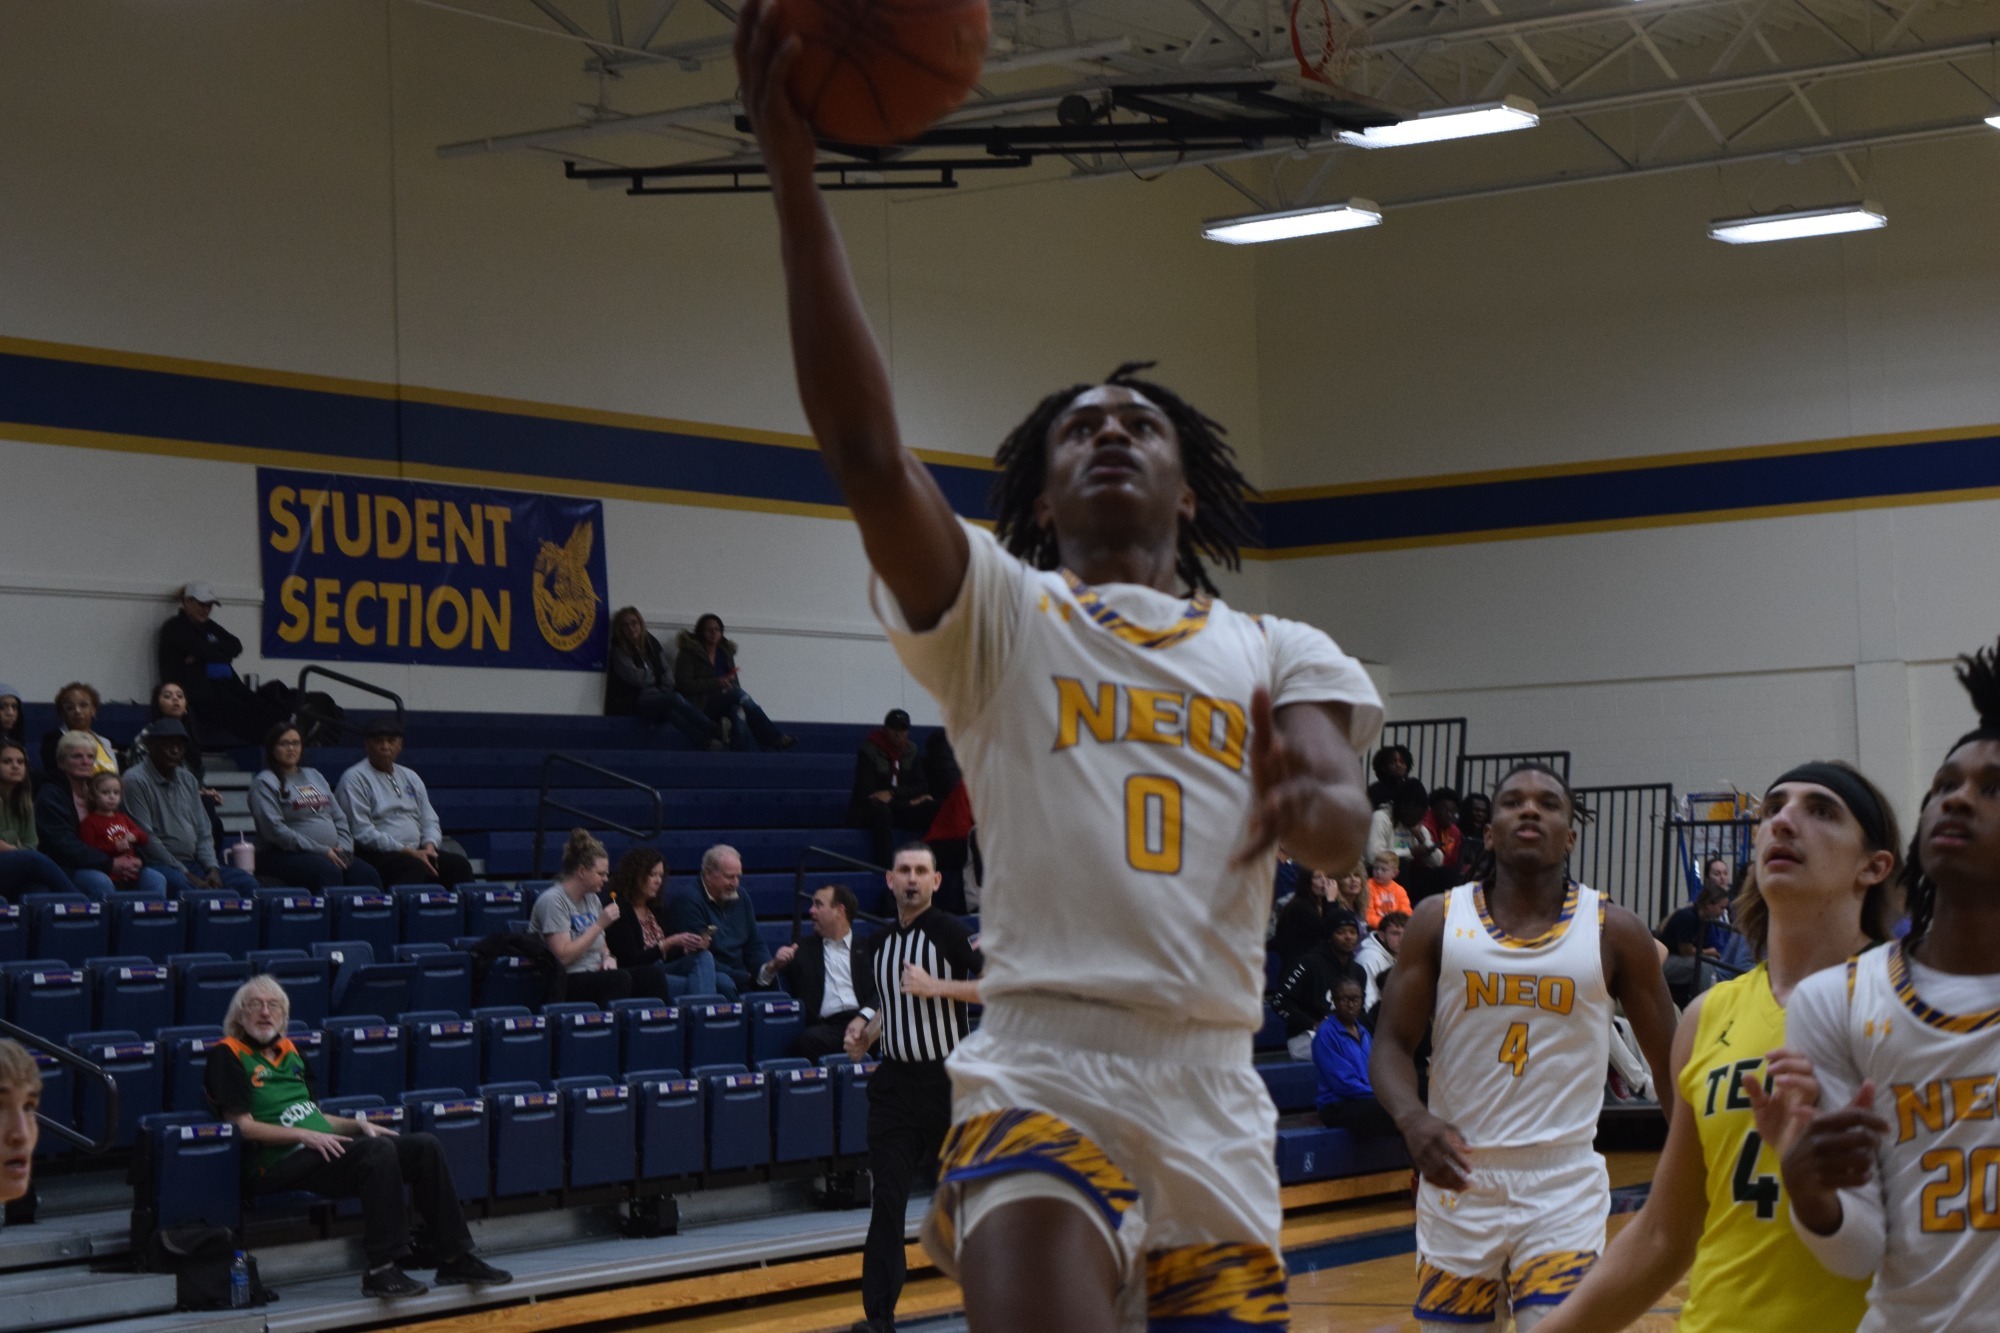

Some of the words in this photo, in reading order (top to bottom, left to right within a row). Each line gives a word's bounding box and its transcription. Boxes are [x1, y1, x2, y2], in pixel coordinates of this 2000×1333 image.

[268, 485, 512, 567] STUDENT
[277, 575, 511, 651] SECTION
[1052, 676, 1248, 771] NEO
[1124, 773, 1183, 875] 0
[1463, 970, 1576, 1015] NEO
[1498, 1022, 1530, 1077] 4
[1891, 1074, 2000, 1146] NE
[1732, 1129, 1780, 1222] 4
[1920, 1146, 2000, 1234] 20
